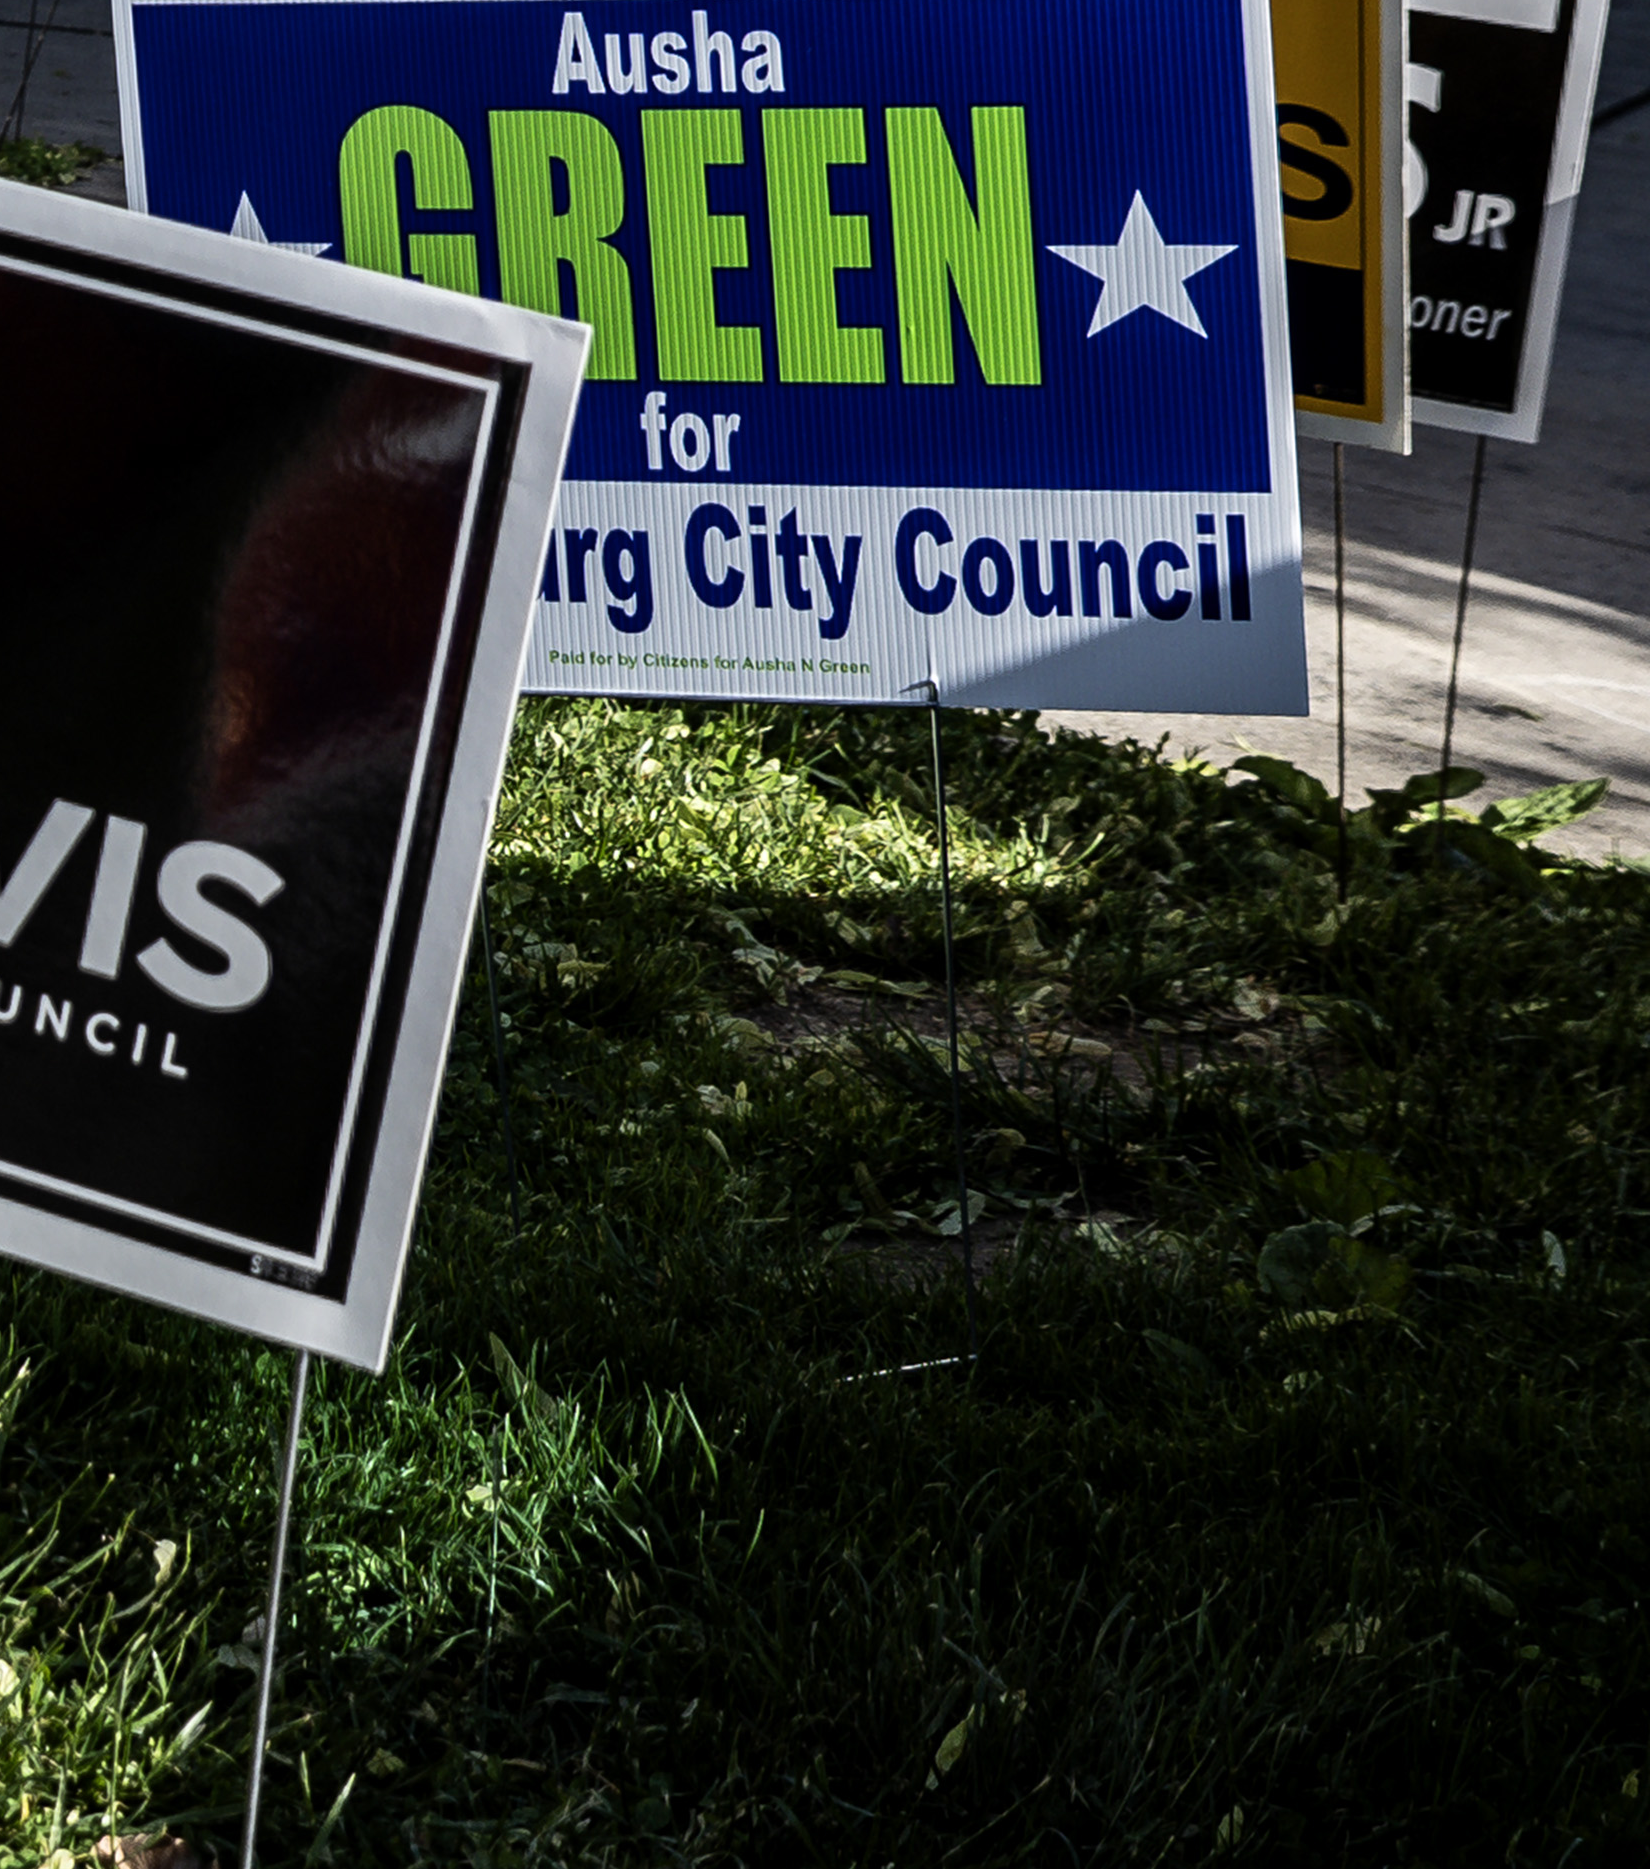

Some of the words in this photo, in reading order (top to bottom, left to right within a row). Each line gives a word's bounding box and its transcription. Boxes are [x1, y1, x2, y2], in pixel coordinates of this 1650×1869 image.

[551, 9, 786, 95] Ausha
[338, 104, 1042, 386] GREEN
[1433, 188, 1516, 250] JR
[640, 390, 742, 474] for
[684, 501, 862, 640] City
[895, 506, 1252, 626] Council
[550, 649, 585, 666] Paid
[590, 650, 613, 666] for
[618, 652, 638, 669] by
[643, 652, 708, 669] Citizens
[714, 654, 737, 670] for
[742, 656, 796, 672] Ausha
[801, 657, 814, 672] N
[819, 658, 871, 674] Green
